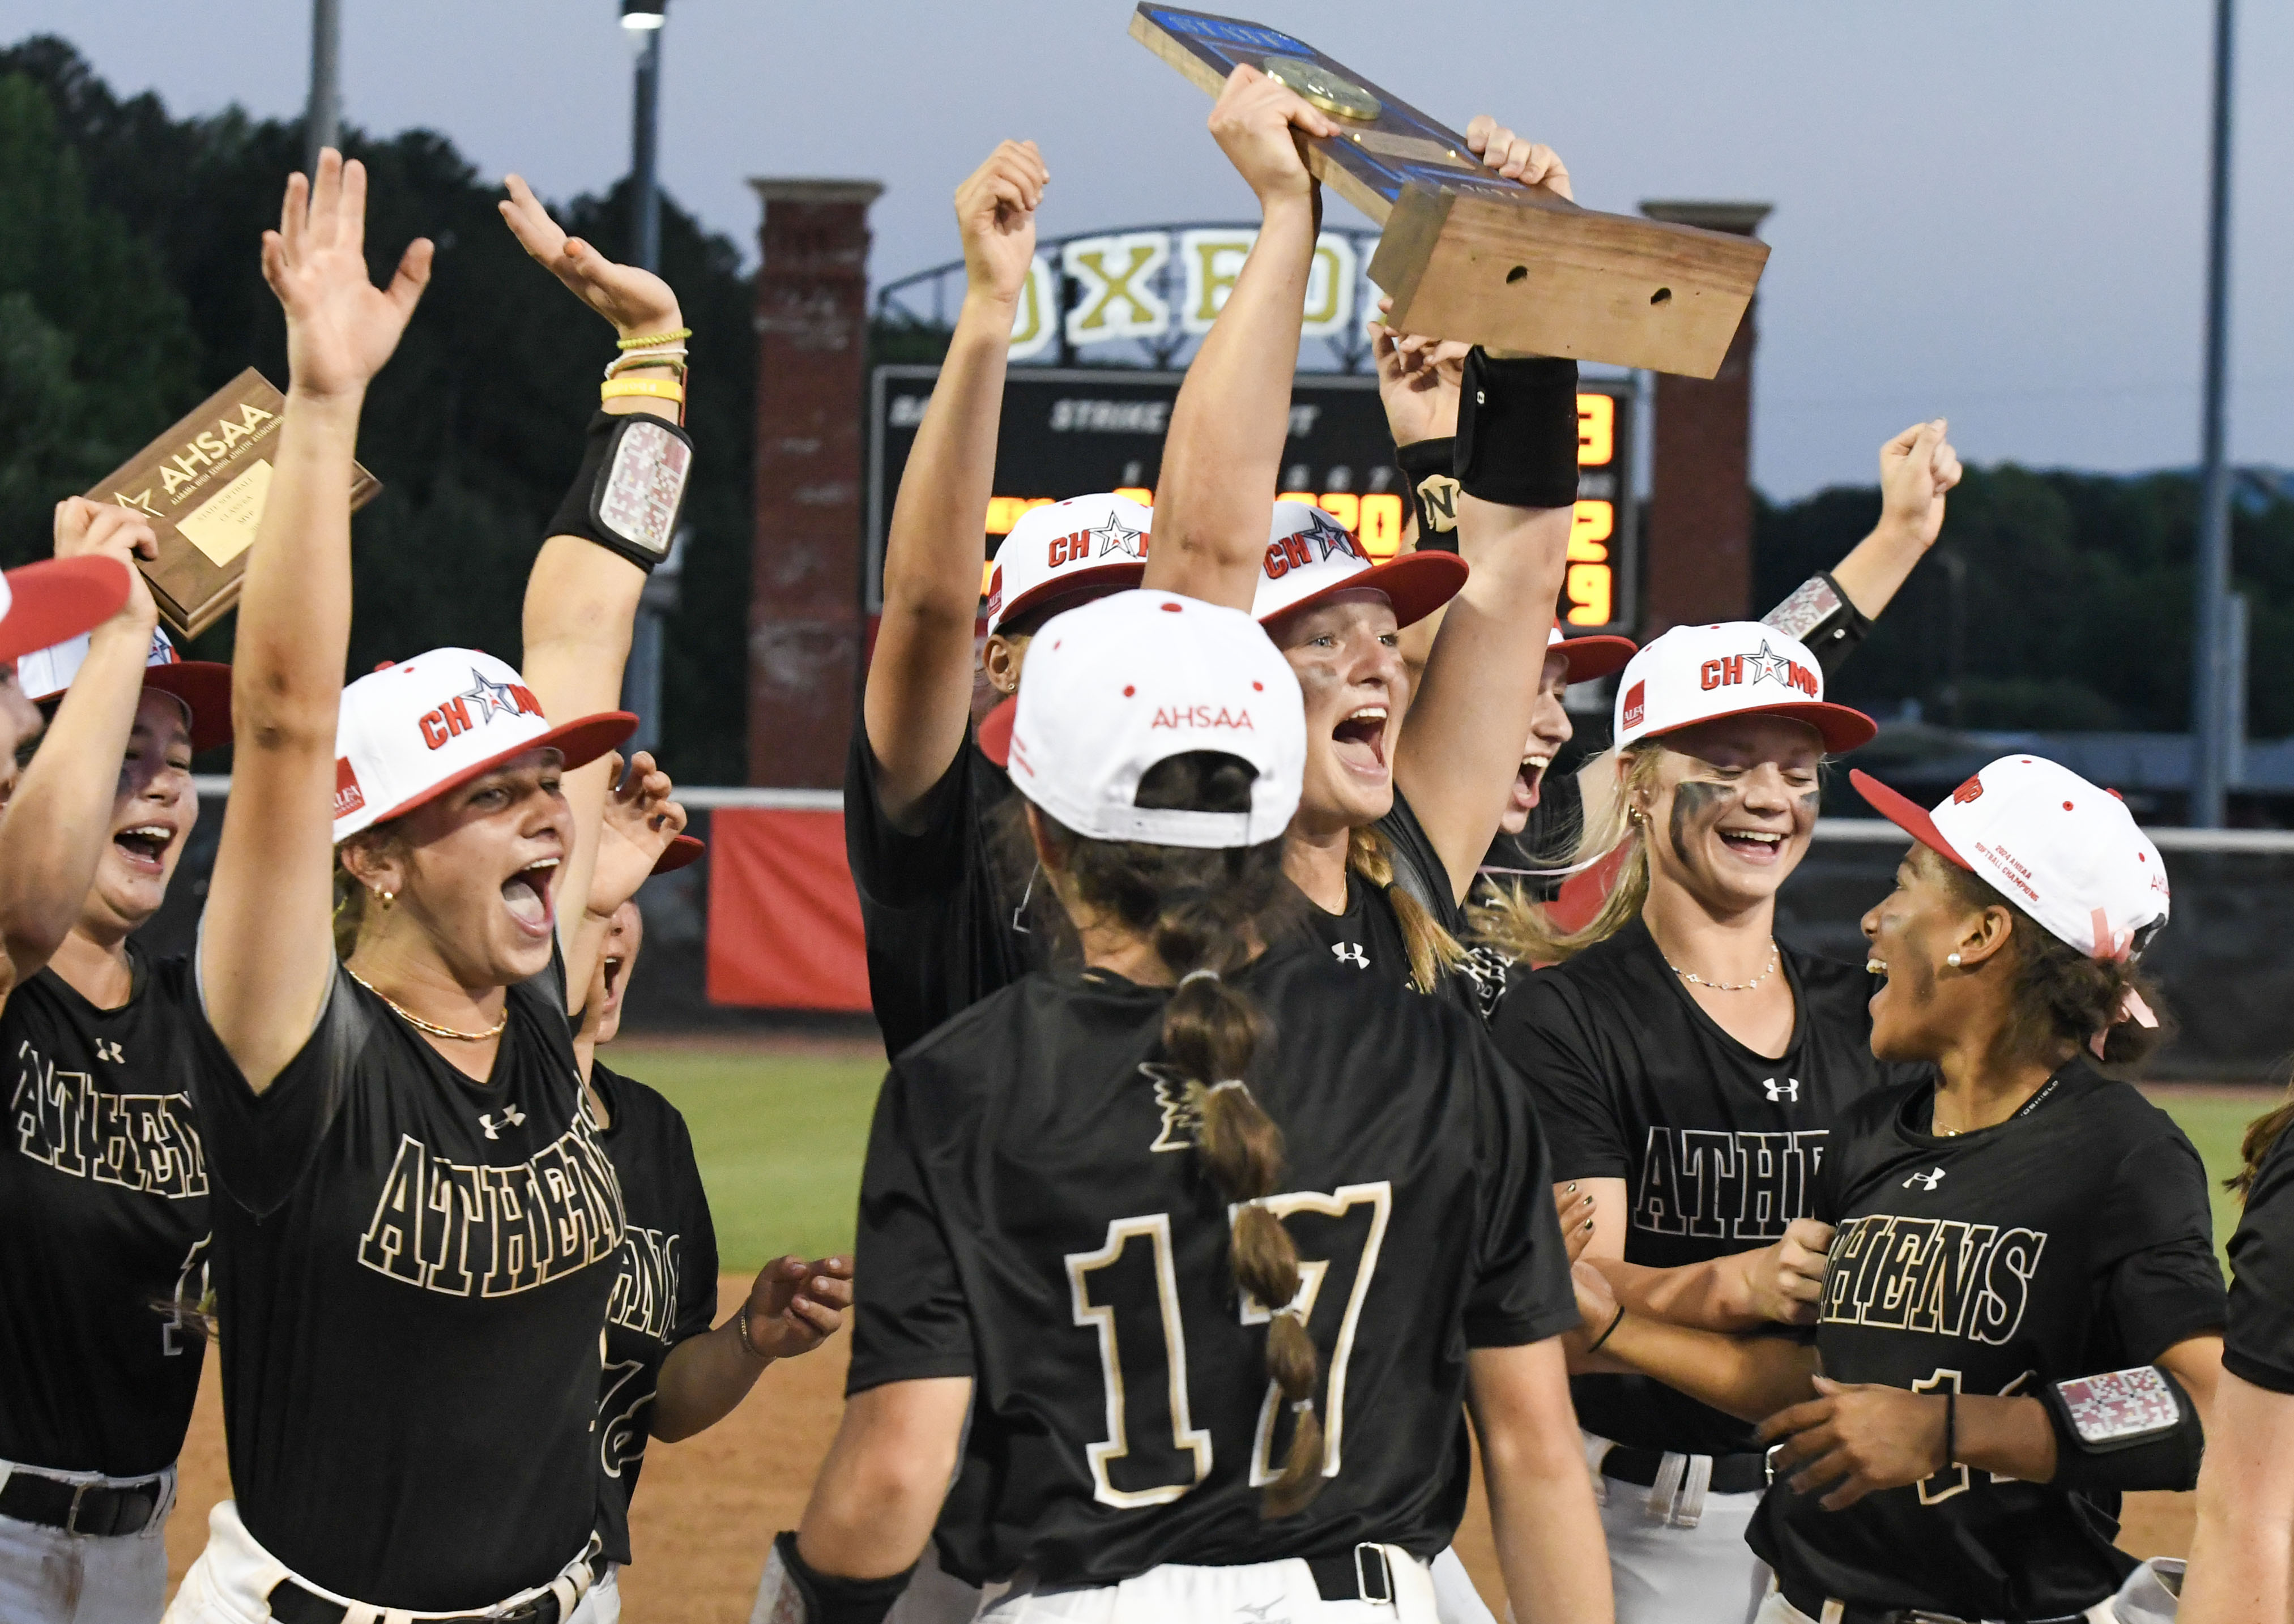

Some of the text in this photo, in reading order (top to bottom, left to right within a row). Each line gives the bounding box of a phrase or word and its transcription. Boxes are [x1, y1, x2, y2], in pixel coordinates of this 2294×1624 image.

[159, 403, 273, 495] AHSAA
[1567, 563, 1612, 627] 9
[1152, 706, 1254, 731] AHSAA
[1975, 842, 2039, 902] SOFTBALL CHAMPIONS
[1995, 845, 2032, 880] 2024 AHSAA
[2020, 1080, 2058, 1117] OSHIELD
[1064, 1180, 1392, 1510] 17
